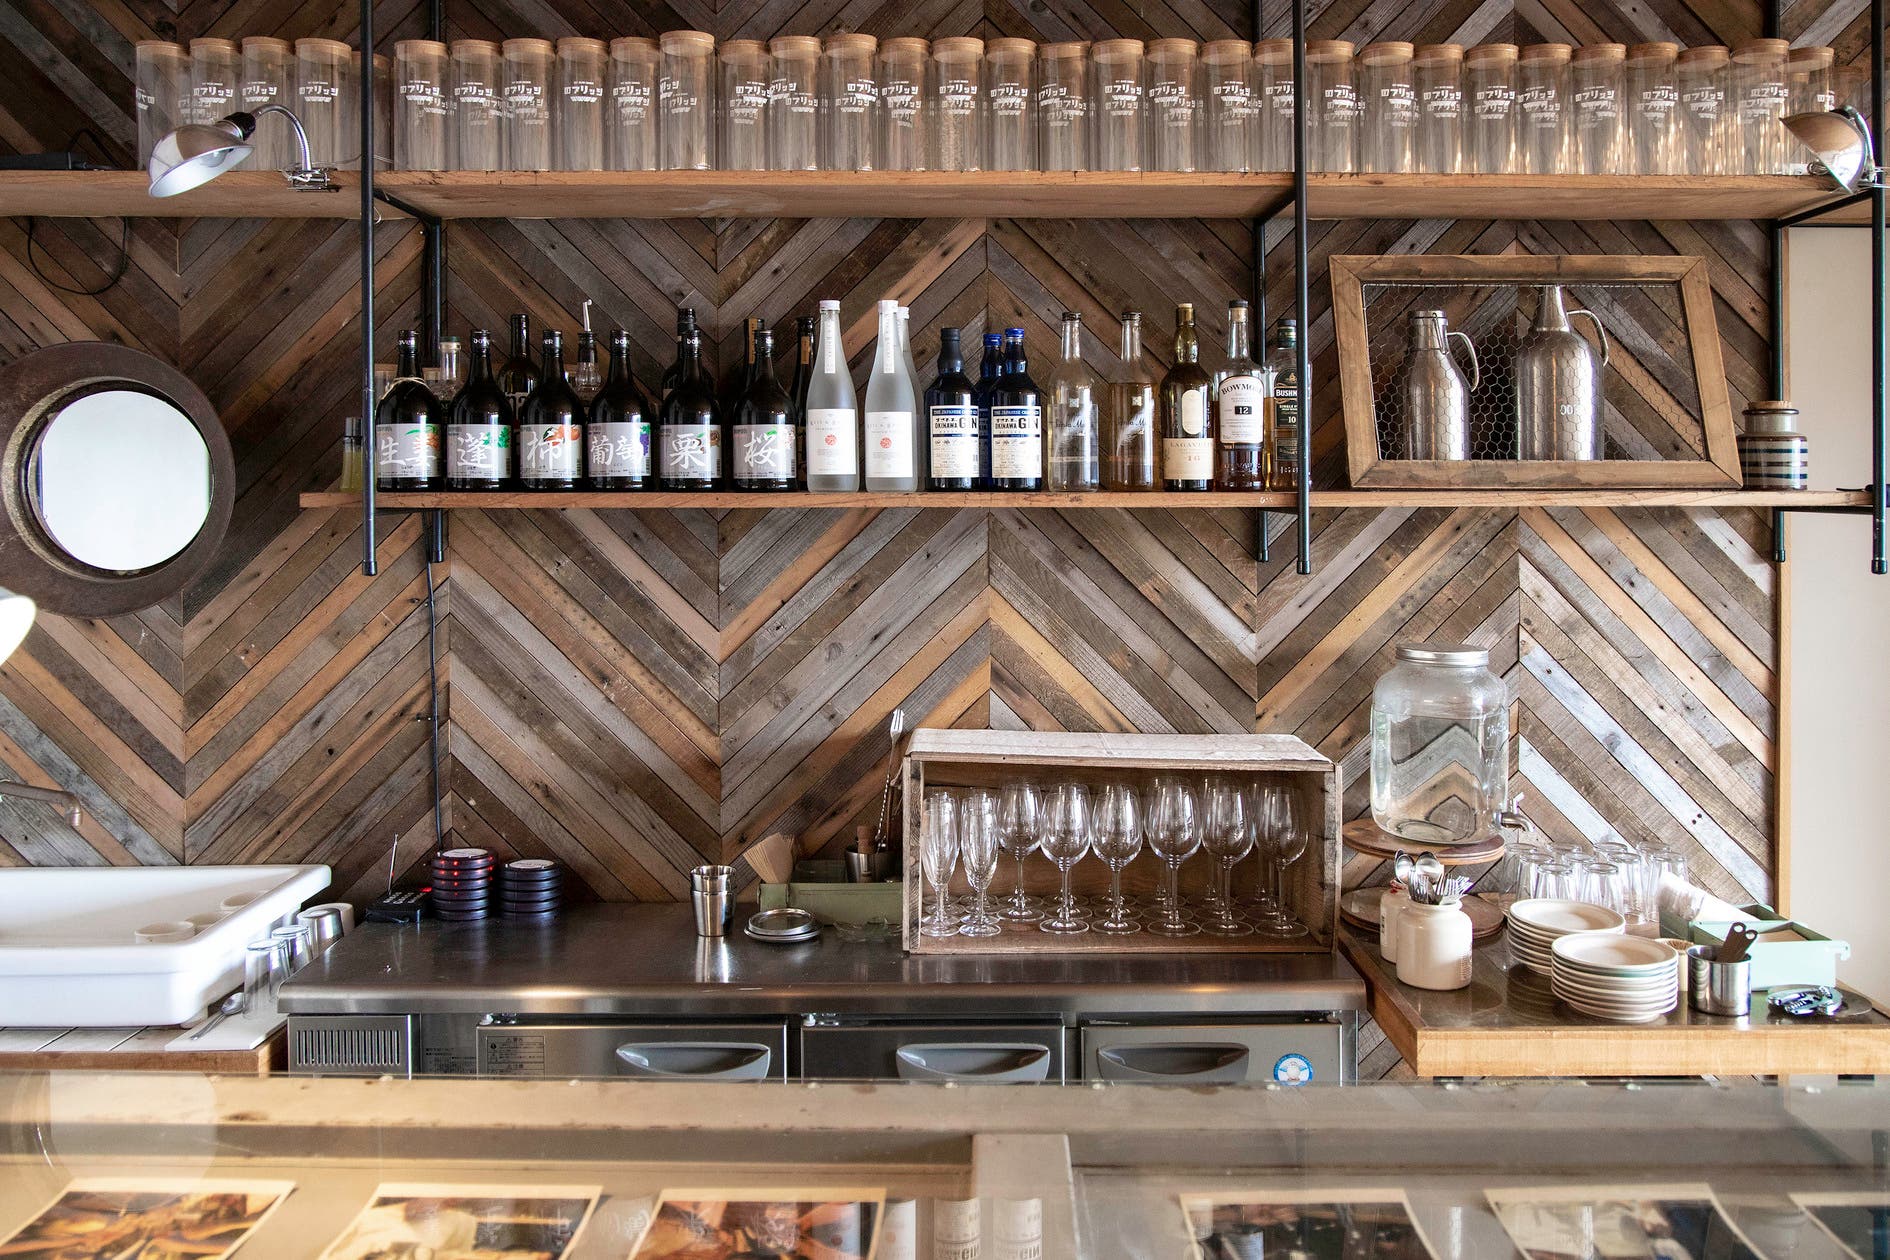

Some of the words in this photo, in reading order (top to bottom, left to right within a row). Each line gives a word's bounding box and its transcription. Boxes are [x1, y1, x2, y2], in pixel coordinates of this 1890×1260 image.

[1239, 406, 1249, 414] 12
[959, 417, 978, 429] GN
[669, 432, 707, 469] 栗
[743, 430, 783, 468] 桜
